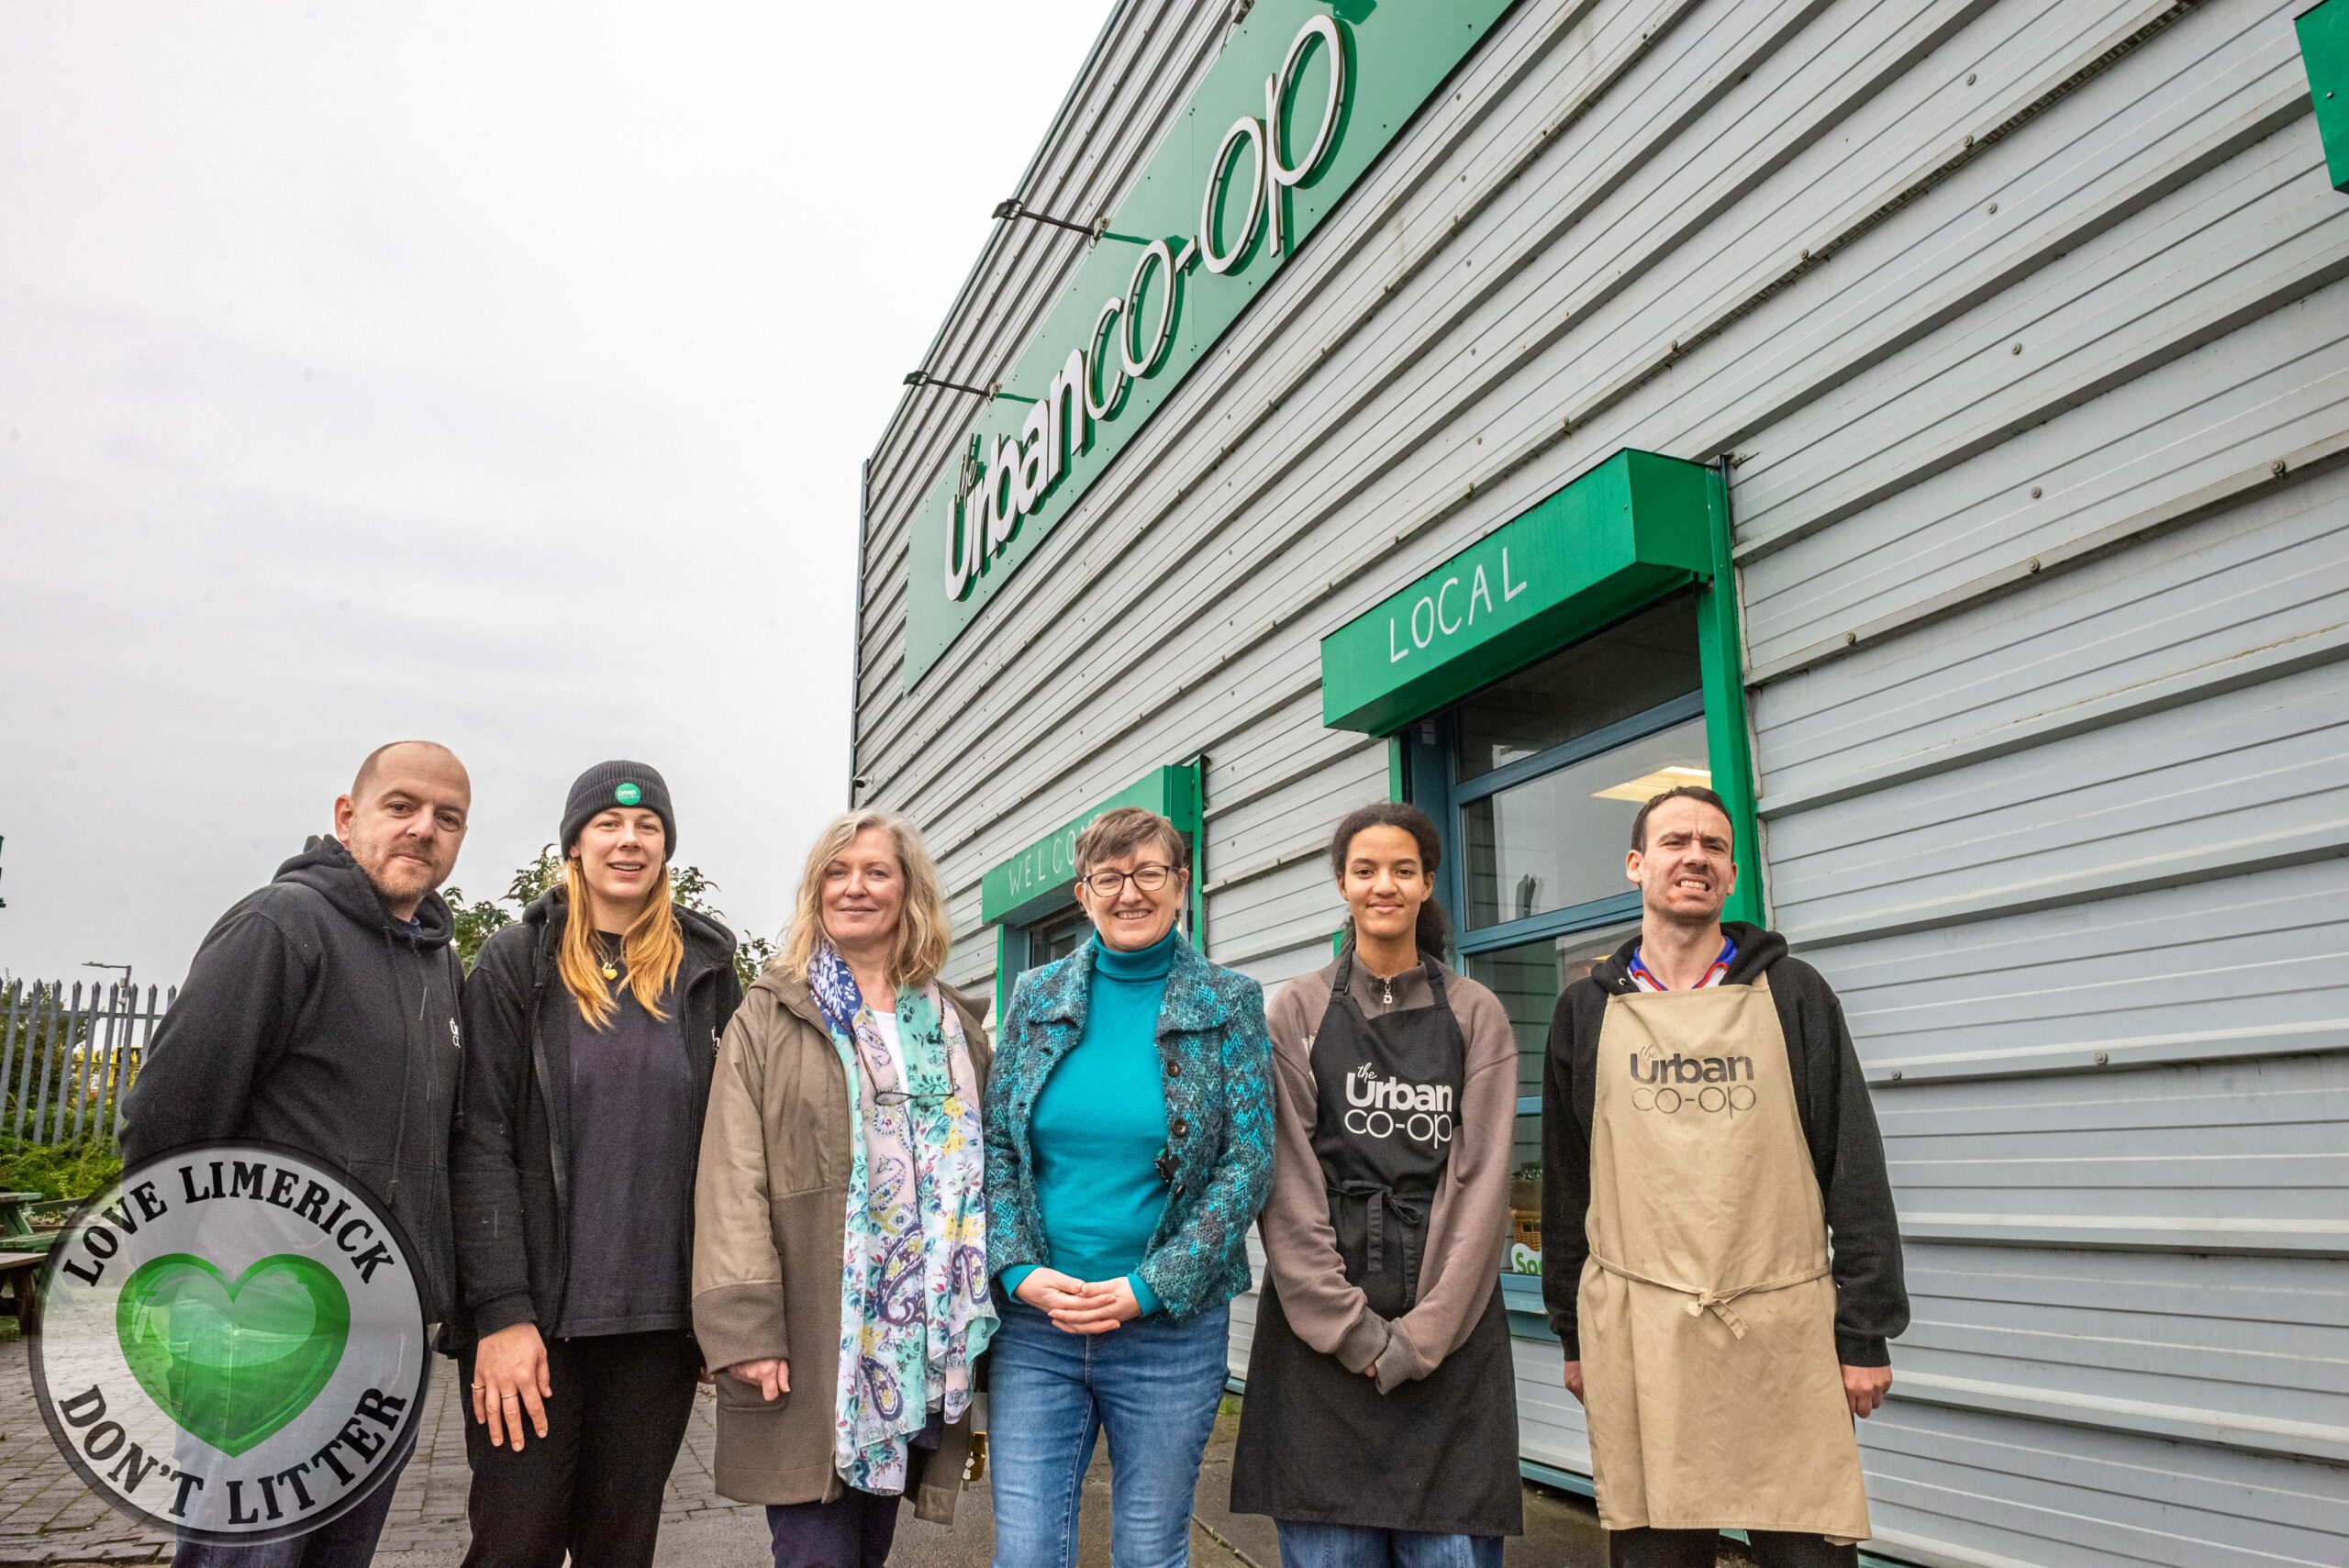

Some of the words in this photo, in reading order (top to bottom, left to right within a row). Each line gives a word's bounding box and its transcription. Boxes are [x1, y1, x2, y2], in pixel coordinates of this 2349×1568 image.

[945, 349, 1088, 602] Urban
[958, 432, 979, 509] the
[1389, 547, 1527, 663] LOCAL
[1008, 812, 1102, 897] WELCO
[1357, 1062, 1377, 1084] the
[1630, 1052, 1754, 1084] Urban
[1639, 1044, 1660, 1062] the
[1345, 1072, 1453, 1113] Urban
[1631, 1084, 1756, 1119] co-op
[1344, 1108, 1453, 1149] co-op
